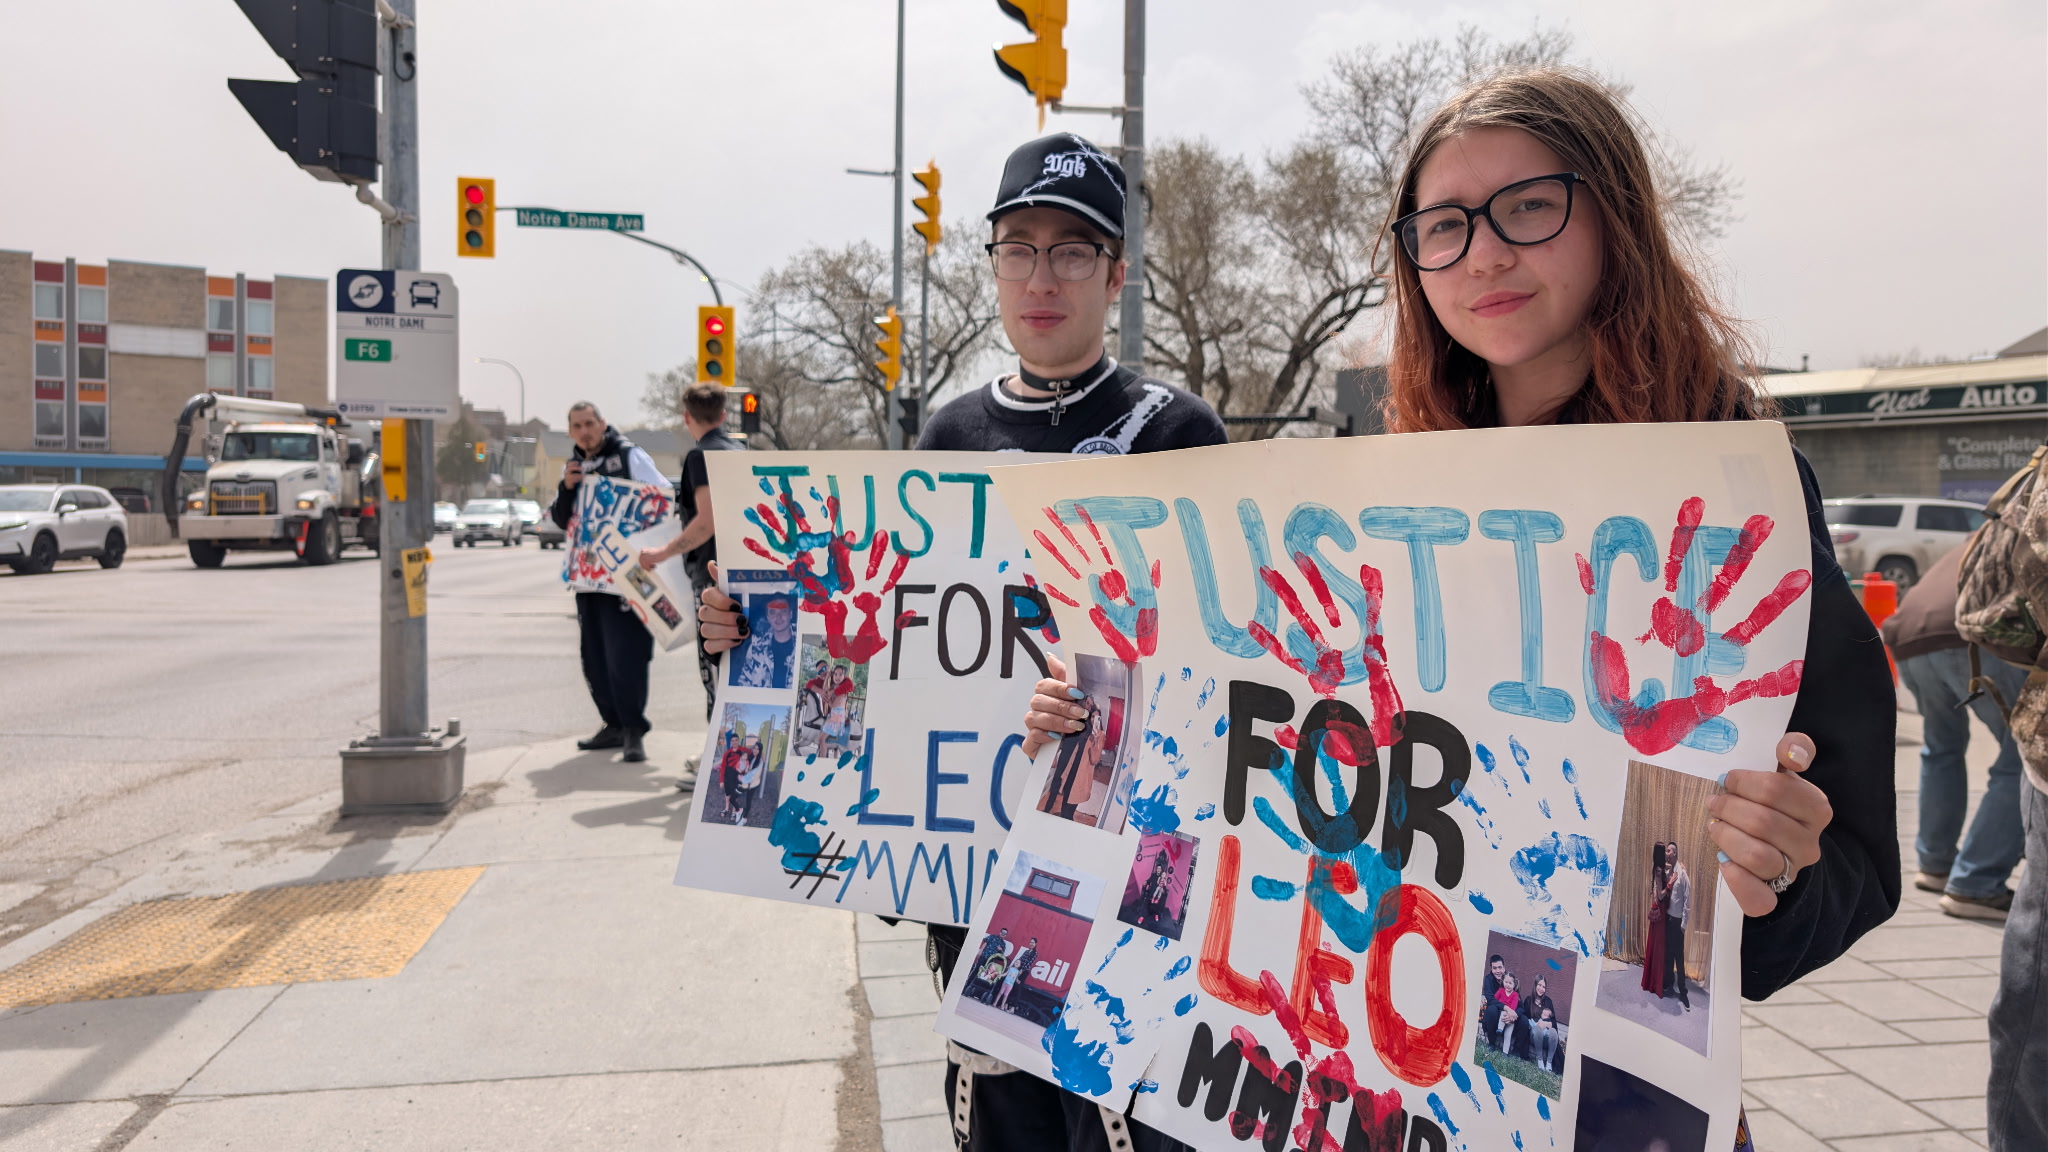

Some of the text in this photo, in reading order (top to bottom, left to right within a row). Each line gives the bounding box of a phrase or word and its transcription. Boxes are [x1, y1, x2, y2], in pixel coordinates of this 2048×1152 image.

[520, 210, 642, 230] Notre Dame Ave
[358, 342, 379, 359] F6
[365, 317, 424, 329] NOTRE DAME
[1960, 384, 2037, 409] Auto
[1953, 453, 2001, 470] Glass
[2003, 452, 2032, 470] Re
[752, 465, 1031, 558] JUST
[890, 583, 1055, 680] FOR
[1053, 495, 1746, 753] JUSTICE
[1223, 679, 1471, 889] FOR
[1197, 834, 1467, 1088] LEO
